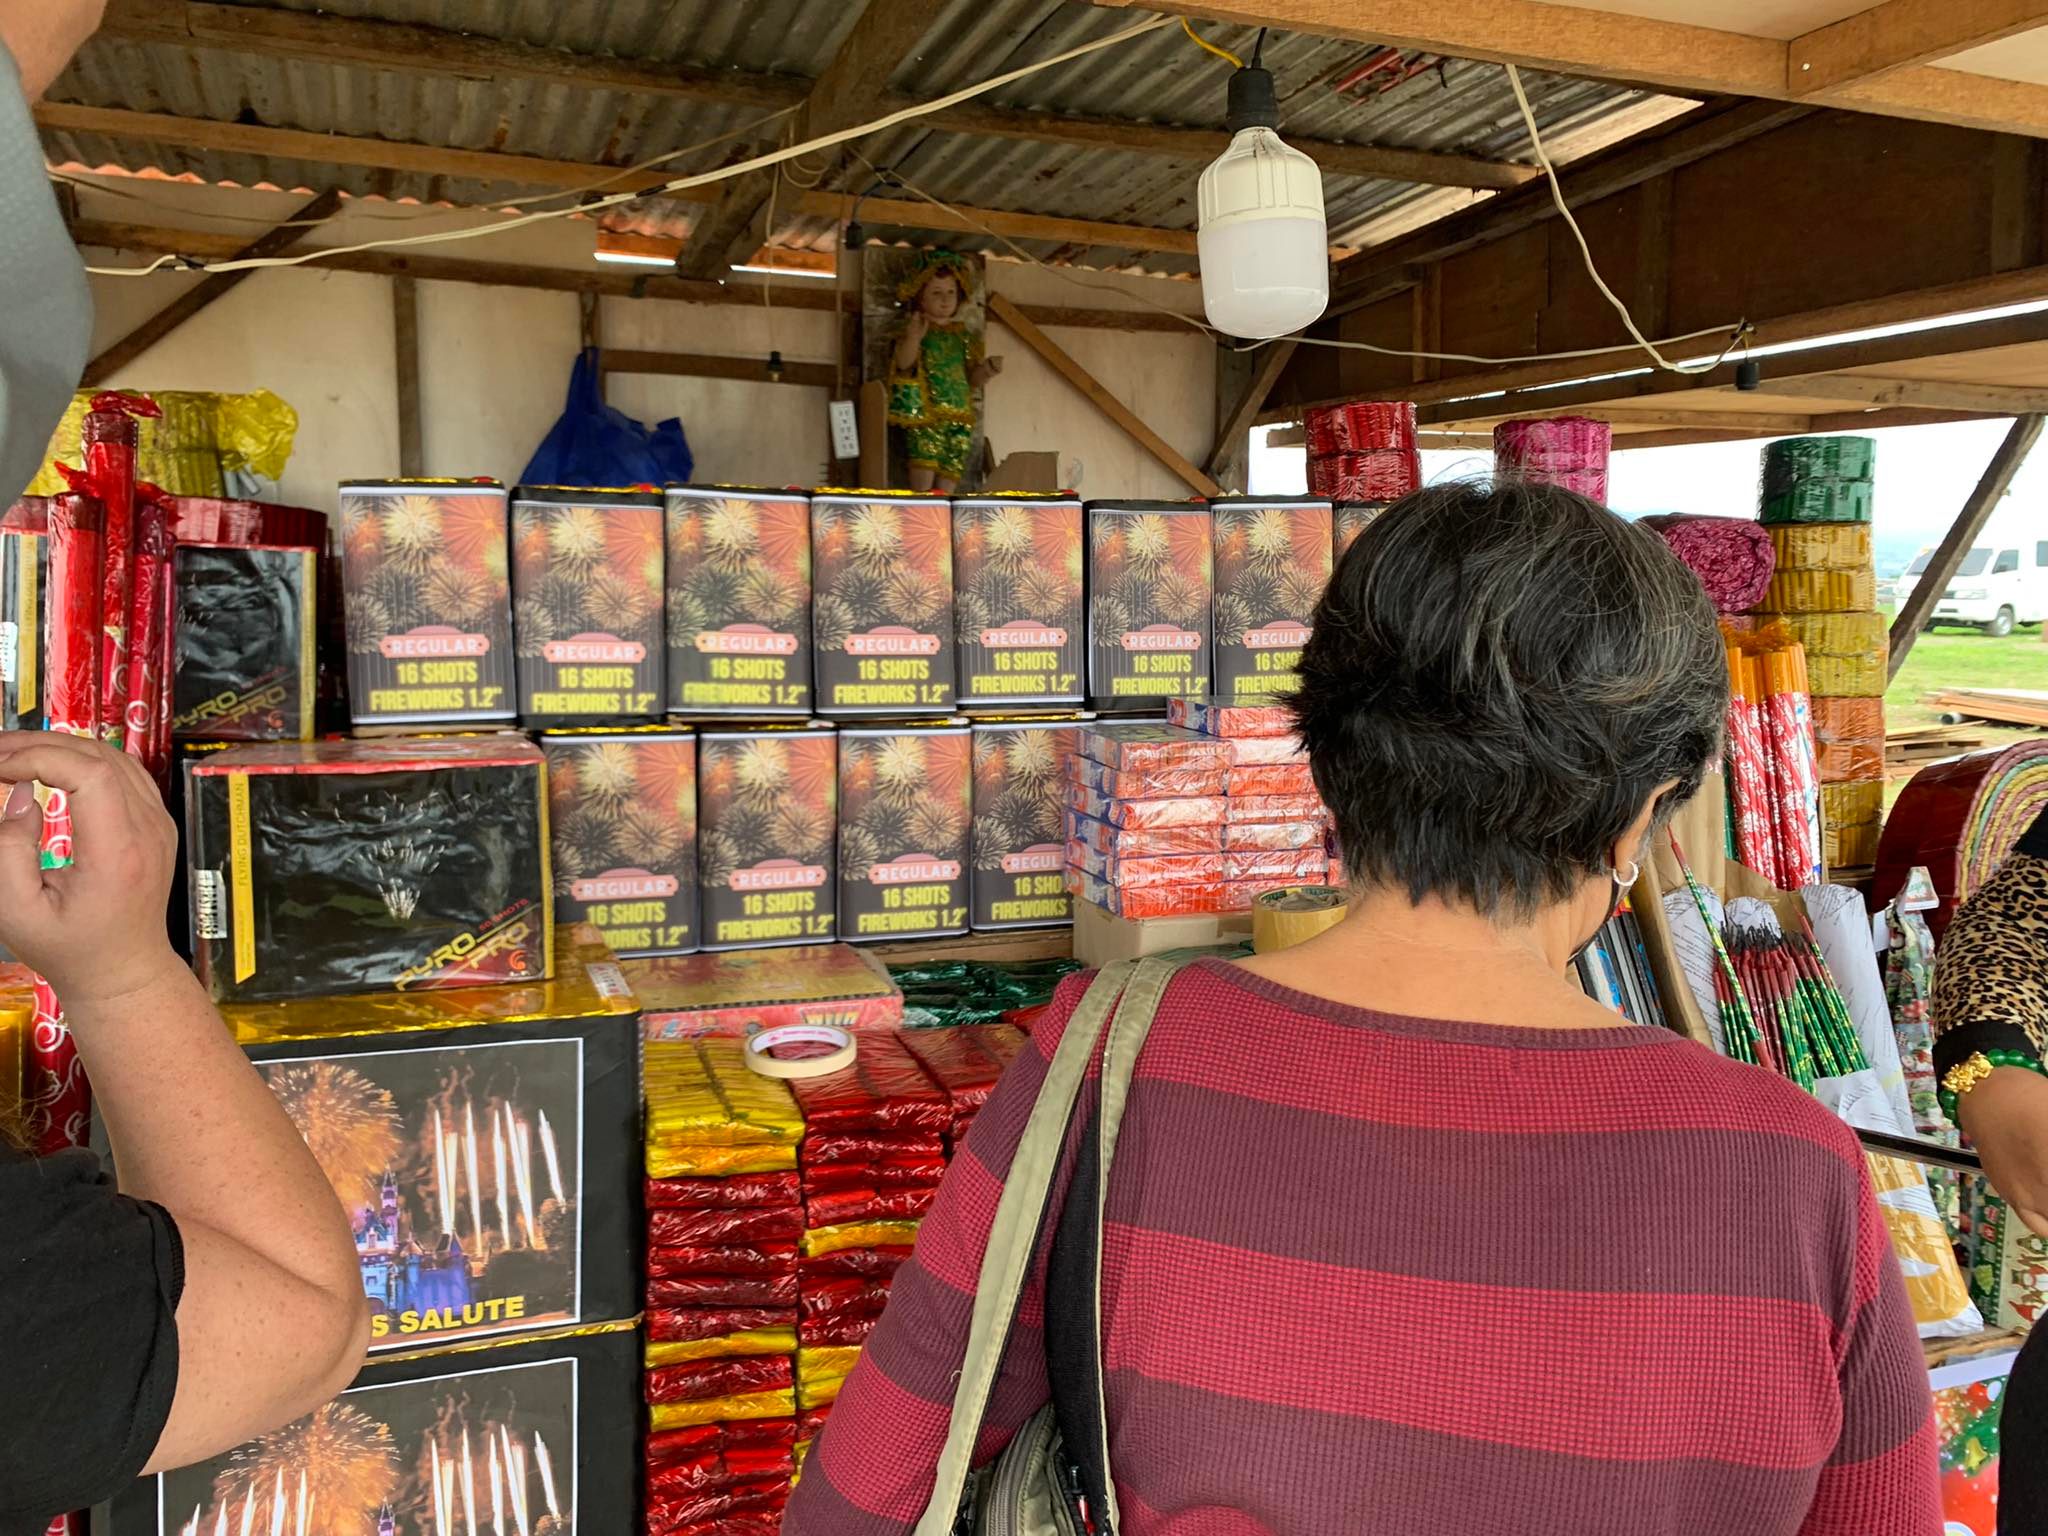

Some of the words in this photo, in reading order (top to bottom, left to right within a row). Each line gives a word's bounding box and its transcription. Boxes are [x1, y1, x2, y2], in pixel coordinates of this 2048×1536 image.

[391, 638, 477, 654] REGULAR
[707, 637, 787, 650] REGULAR
[855, 639, 930, 651] REGULAR
[990, 633, 1056, 645] REGULAR
[1130, 636, 1192, 648] REGULAR
[1252, 632, 1305, 645] REGULA
[555, 646, 635, 660] REGULAR
[994, 653, 1009, 670] 16
[1014, 652, 1057, 669] SHOTS
[1255, 653, 1270, 671] 16
[1273, 651, 1303, 670] SHO
[397, 664, 417, 684] 16
[422, 662, 477, 683] SHOTS
[710, 659, 730, 678] 16
[734, 660, 785, 680] SHOTS
[859, 660, 876, 680] 16
[880, 660, 929, 680] SHOTS
[1133, 656, 1146, 672] 16
[1151, 655, 1191, 672] SHOTS
[559, 668, 579, 688] 16
[582, 668, 634, 688] SHOTS
[972, 676, 1046, 694] FIREWORKS
[1113, 678, 1181, 695] FIREWORKS
[370, 690, 466, 711] FIREWORKS
[532, 695, 620, 712] FIREWORKS
[683, 683, 771, 704] FIREWORKS
[834, 685, 916, 704] FIREWORKS
[228, 686, 286, 722] PRO
[236, 783, 248, 846] DUTCHMAN
[238, 849, 248, 886] FLYING
[1011, 855, 1059, 869] REGUL
[738, 872, 817, 886] REGULAR
[877, 866, 951, 880] REGULAR
[583, 880, 668, 897] REGULAR
[1014, 878, 1030, 895] 16
[1034, 876, 1062, 894] SHO
[743, 895, 762, 915] 16
[765, 892, 815, 913] SHOTS
[883, 889, 900, 908] 16
[903, 886, 949, 906] SHOTS
[587, 905, 608, 925] 16
[611, 902, 666, 924] SHOTS
[992, 899, 1067, 920] FIREWORKS
[718, 918, 801, 941] FIREWORKS
[859, 910, 936, 933] FIREWORKS
[467, 922, 531, 969] PRO
[394, 932, 476, 991] PYRO
[400, 1296, 525, 1332] SALUTE
